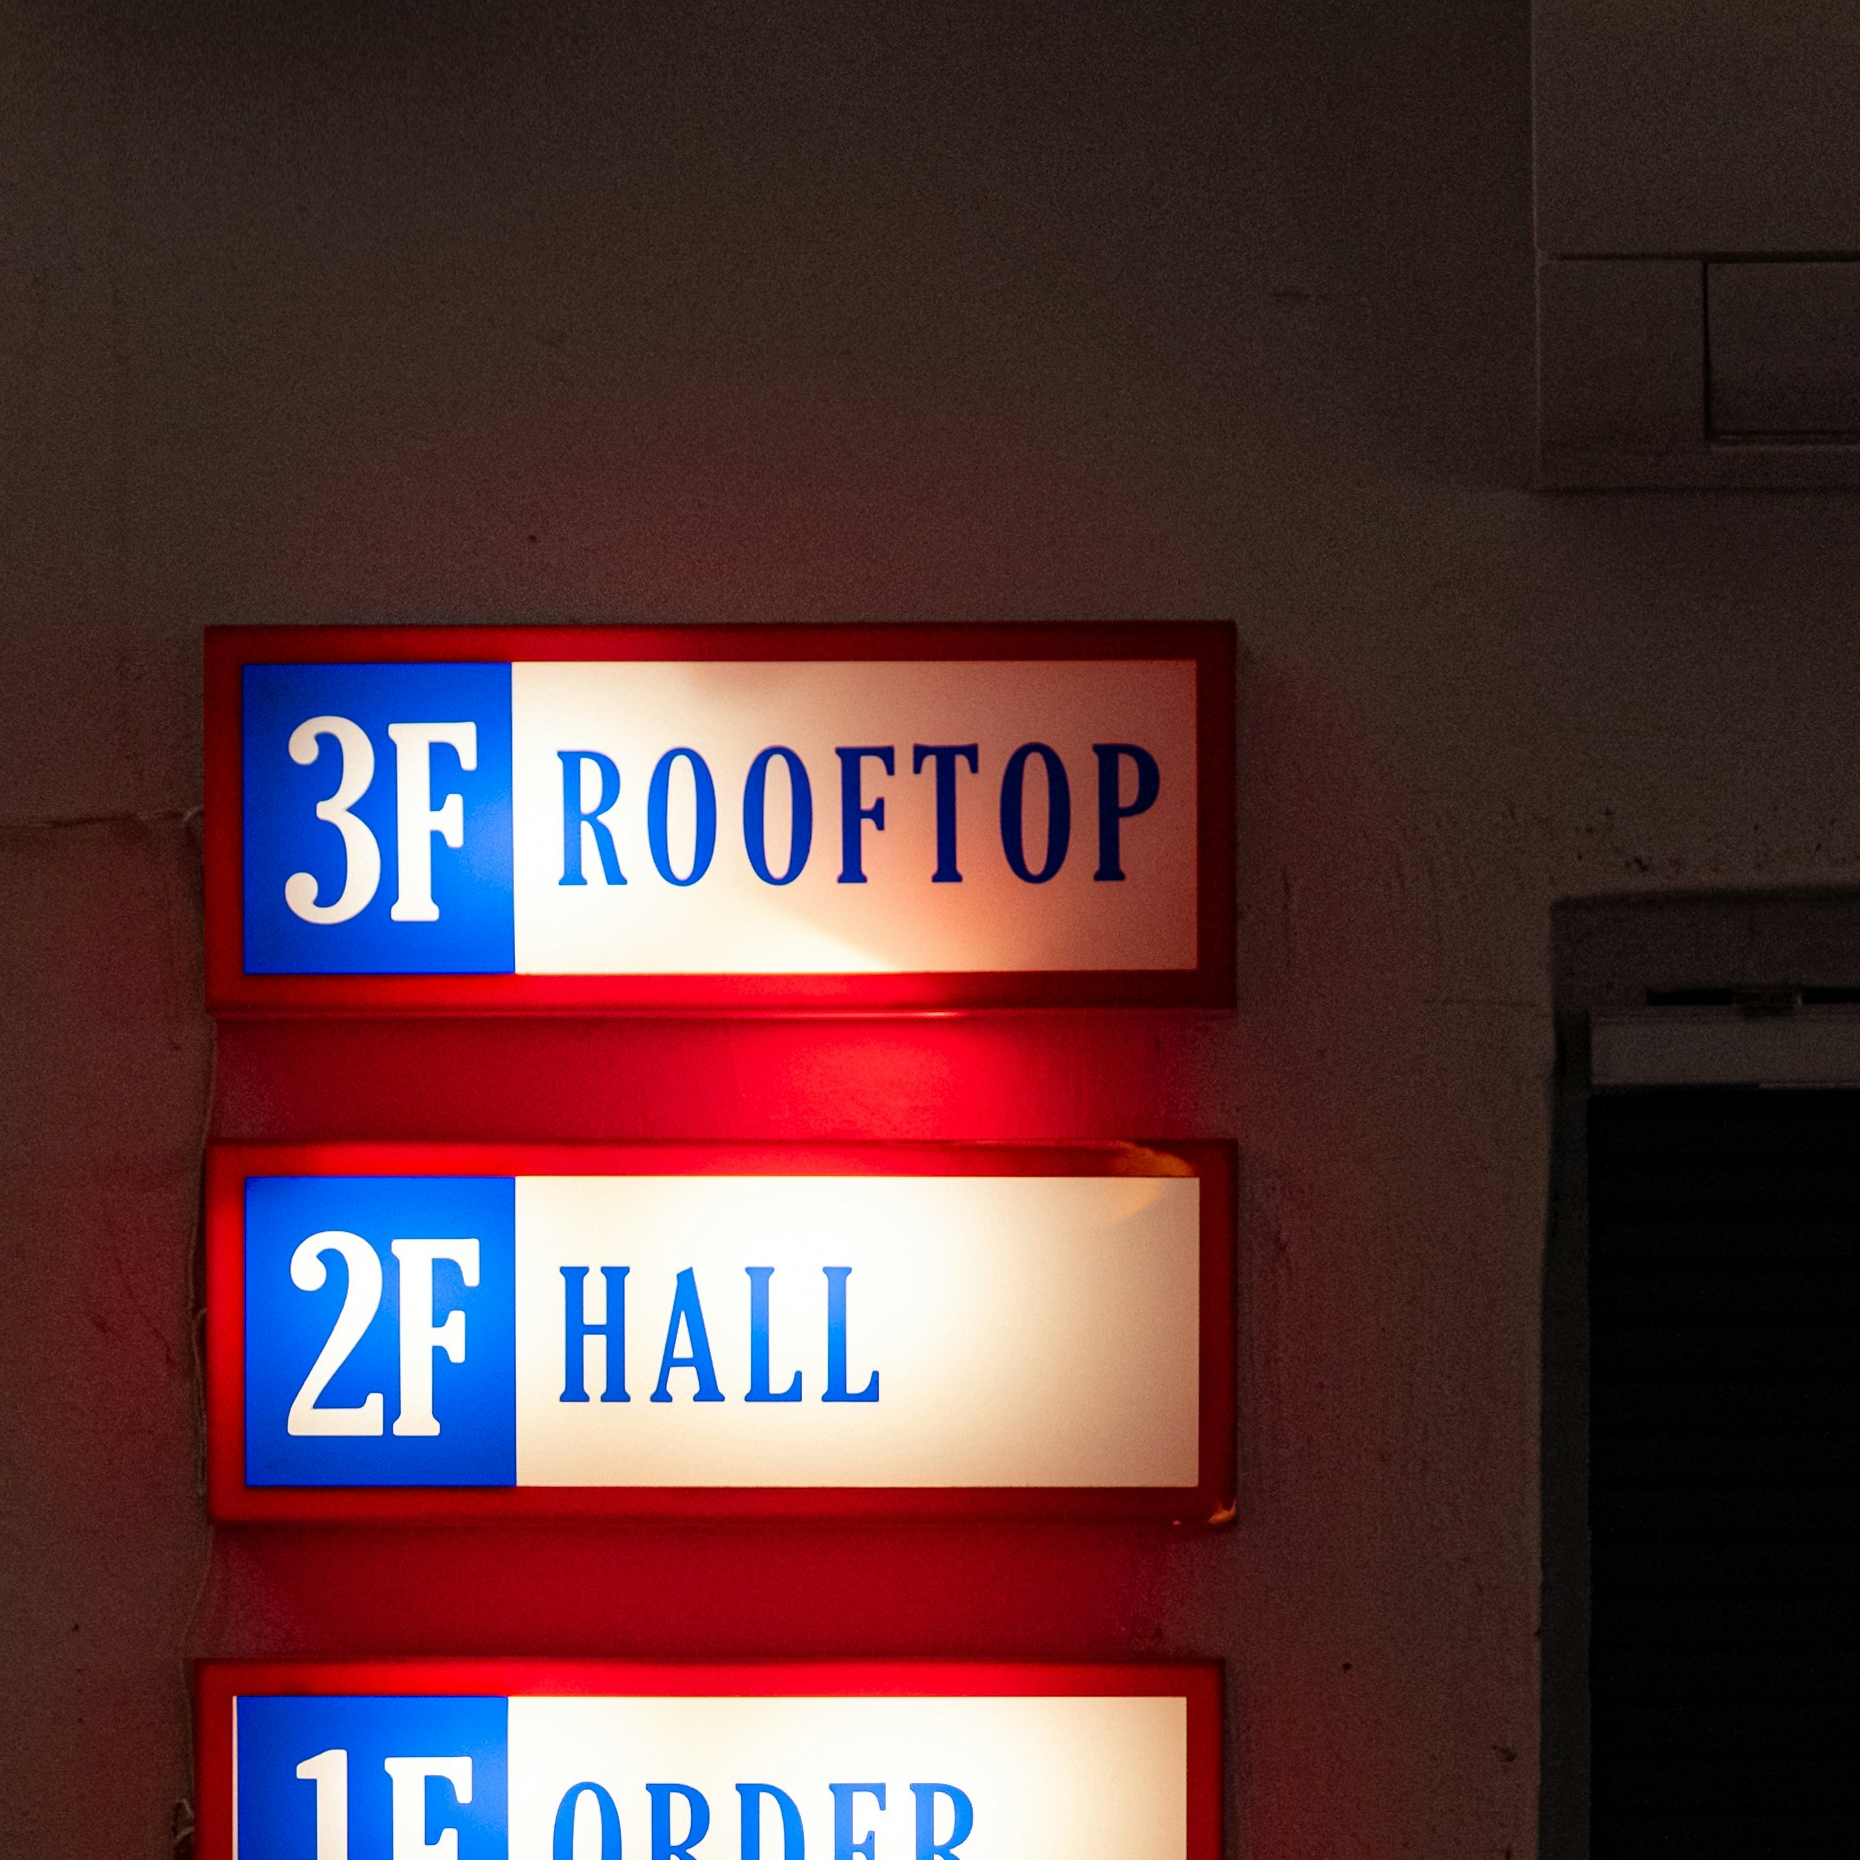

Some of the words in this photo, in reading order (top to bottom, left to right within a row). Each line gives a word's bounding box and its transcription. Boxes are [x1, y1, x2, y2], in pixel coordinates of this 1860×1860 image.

[283, 714, 478, 926] 3F
[556, 741, 1162, 887] ROOFTOP
[286, 1229, 480, 1436] 2F
[557, 1264, 881, 1403] HALL
